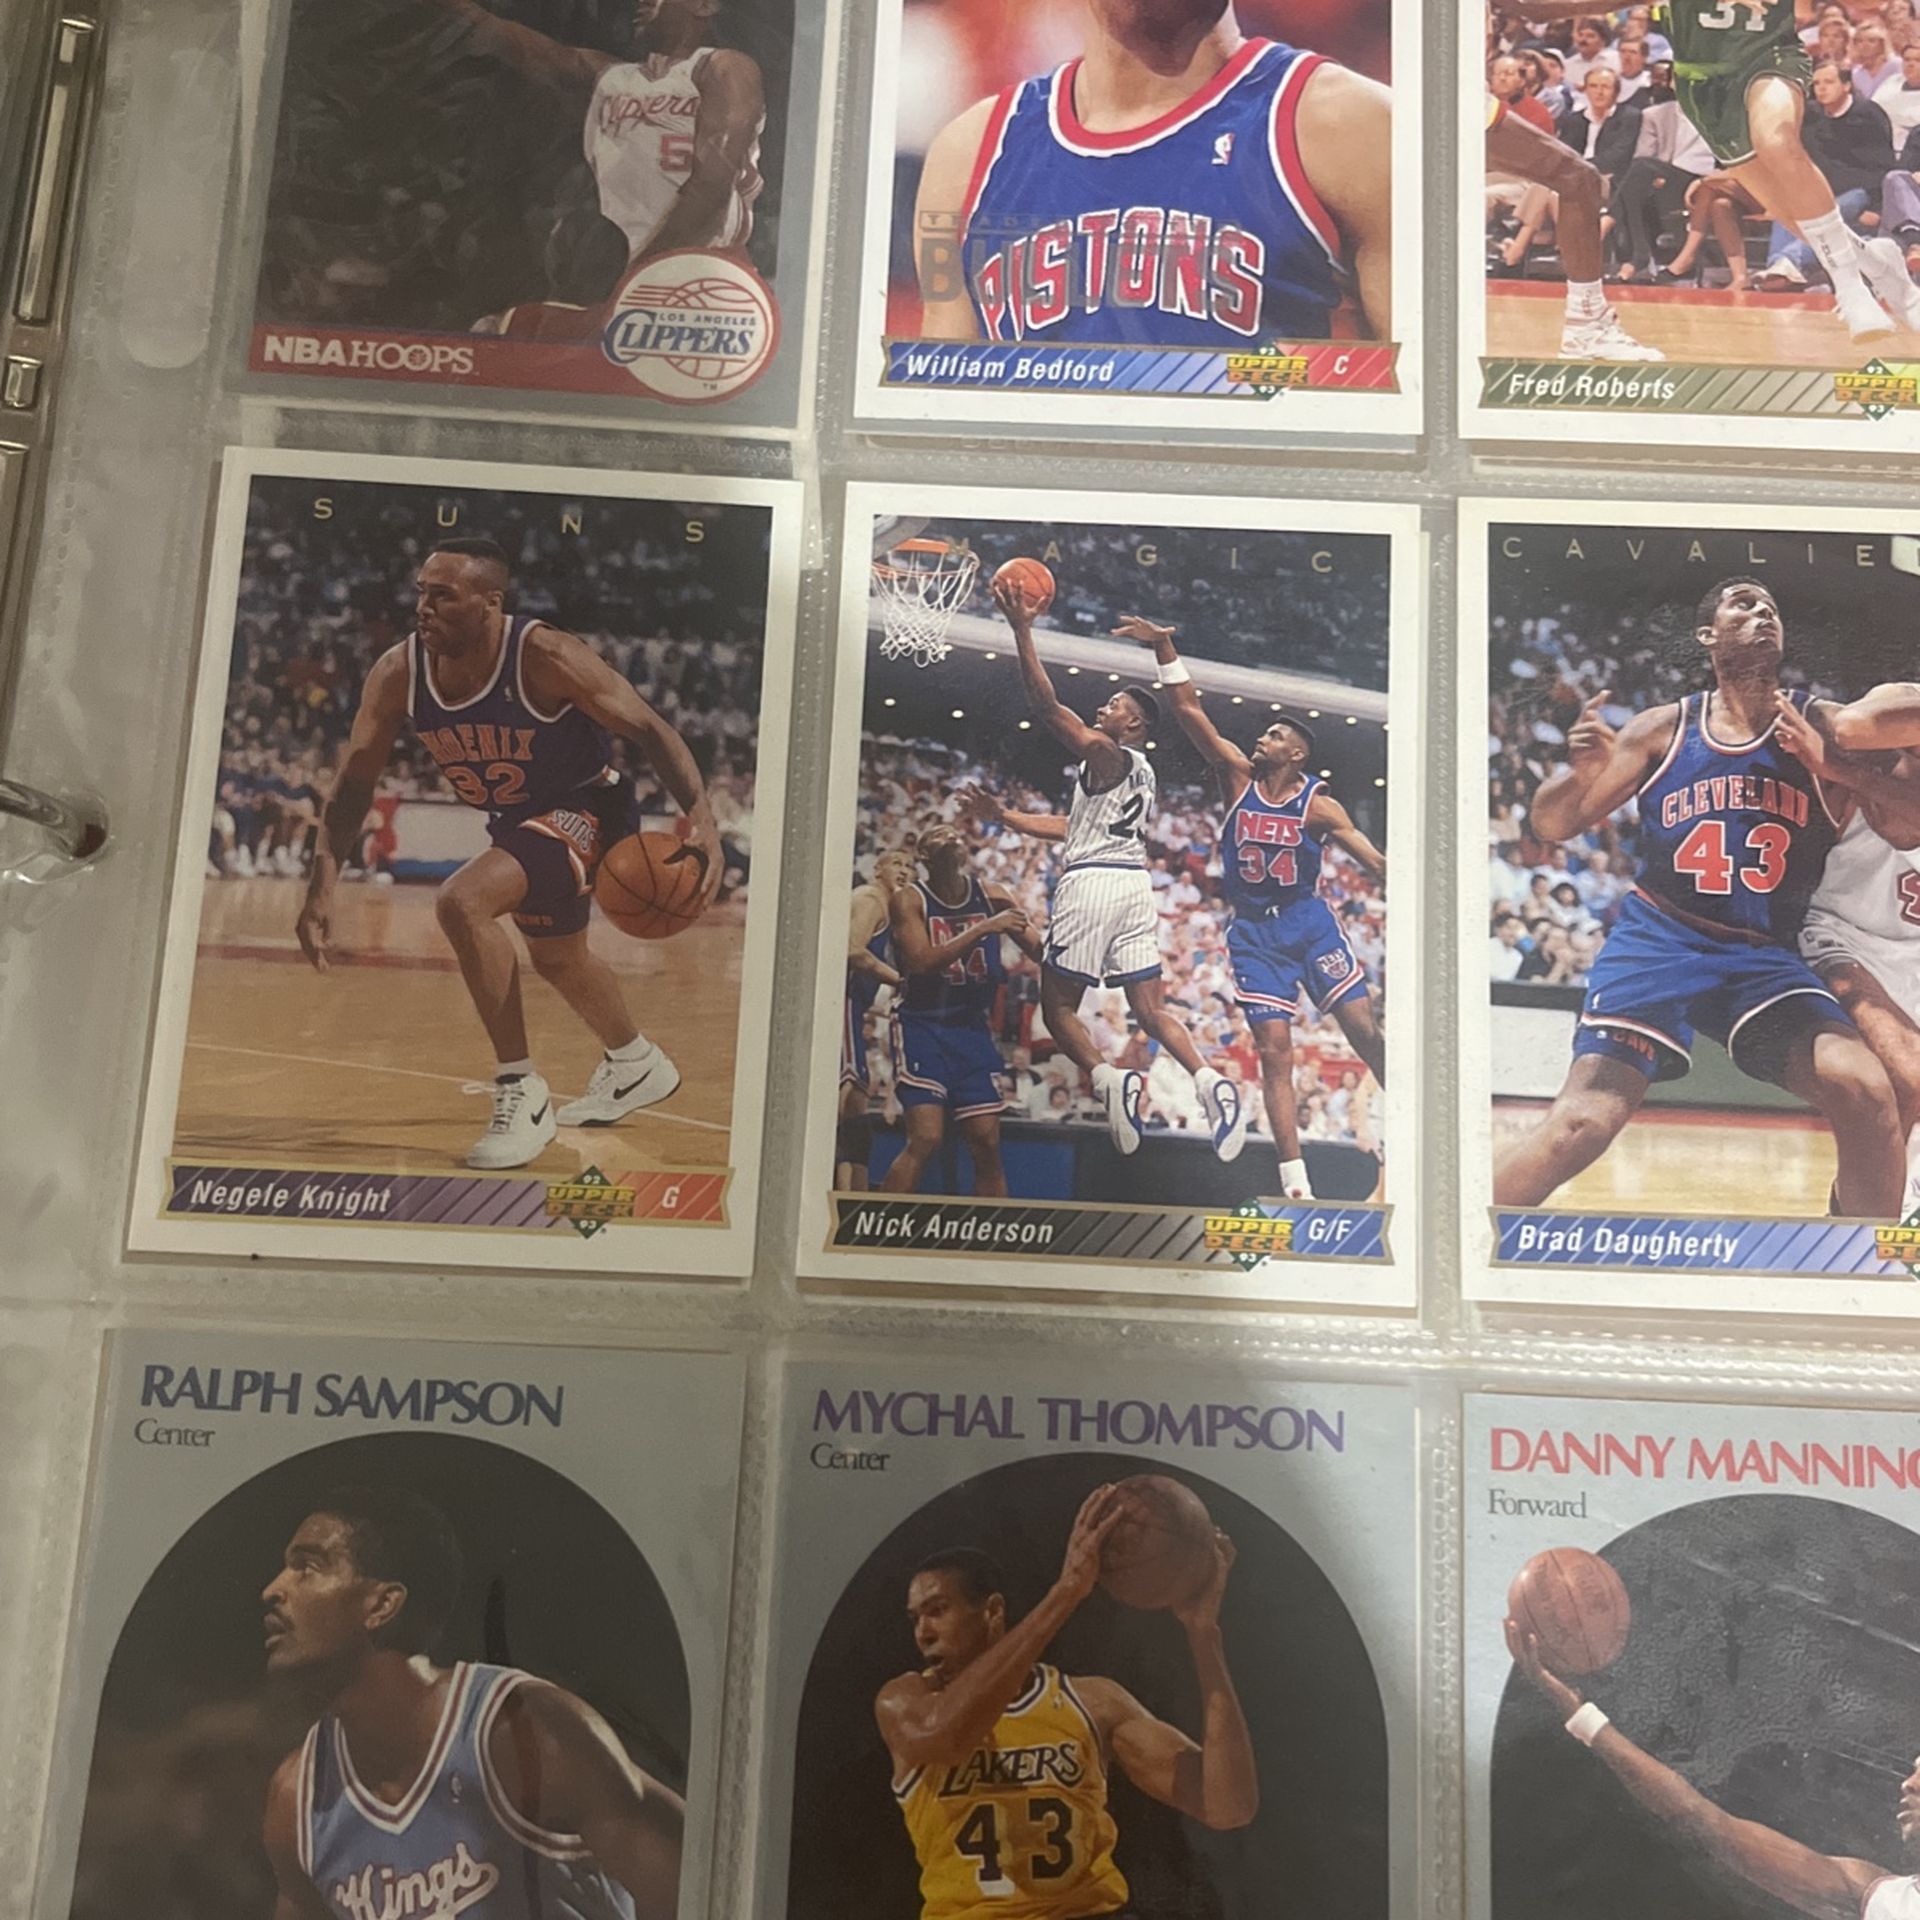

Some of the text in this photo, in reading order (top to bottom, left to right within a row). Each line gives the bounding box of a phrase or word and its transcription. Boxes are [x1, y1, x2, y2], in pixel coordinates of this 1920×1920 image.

[974, 206, 1264, 340] PISTONS
[603, 308, 756, 365] CLIPPERS
[659, 312, 757, 327] LOS ANGELES
[907, 354, 1115, 382] William Bedford
[1228, 357, 1308, 370] UPPER
[1333, 355, 1350, 375] C
[1508, 373, 1676, 400] Fred Roberts
[1835, 376, 1916, 389] UPPER
[1502, 537, 1920, 568] CAVALIE
[444, 762, 531, 806] 32
[1662, 774, 1809, 829] CLEVELAND
[1235, 808, 1305, 849] NETS
[1238, 844, 1298, 887] 34
[1673, 819, 1791, 895] 43
[190, 1179, 391, 1217] Negele Knight
[549, 1187, 635, 1201] UPPER
[661, 1185, 680, 1209] G
[854, 1210, 1054, 1244] Nick Anderson
[1205, 1219, 1293, 1235] UPPER
[1308, 1217, 1352, 1244] G/F
[1517, 1224, 1739, 1264] Brad Daugherty
[140, 1363, 565, 1428] RALPH SAMPSON
[134, 1417, 216, 1448] Center
[812, 1388, 1345, 1454] MYCHAL THOMPSON
[809, 1441, 891, 1473] Center
[1489, 1427, 1676, 1479] DANNY
[1486, 1487, 1588, 1519] Forward
[937, 1740, 1086, 1798] LAKERS
[954, 1796, 1074, 1883] 43
[335, 1841, 500, 1920] Kings
